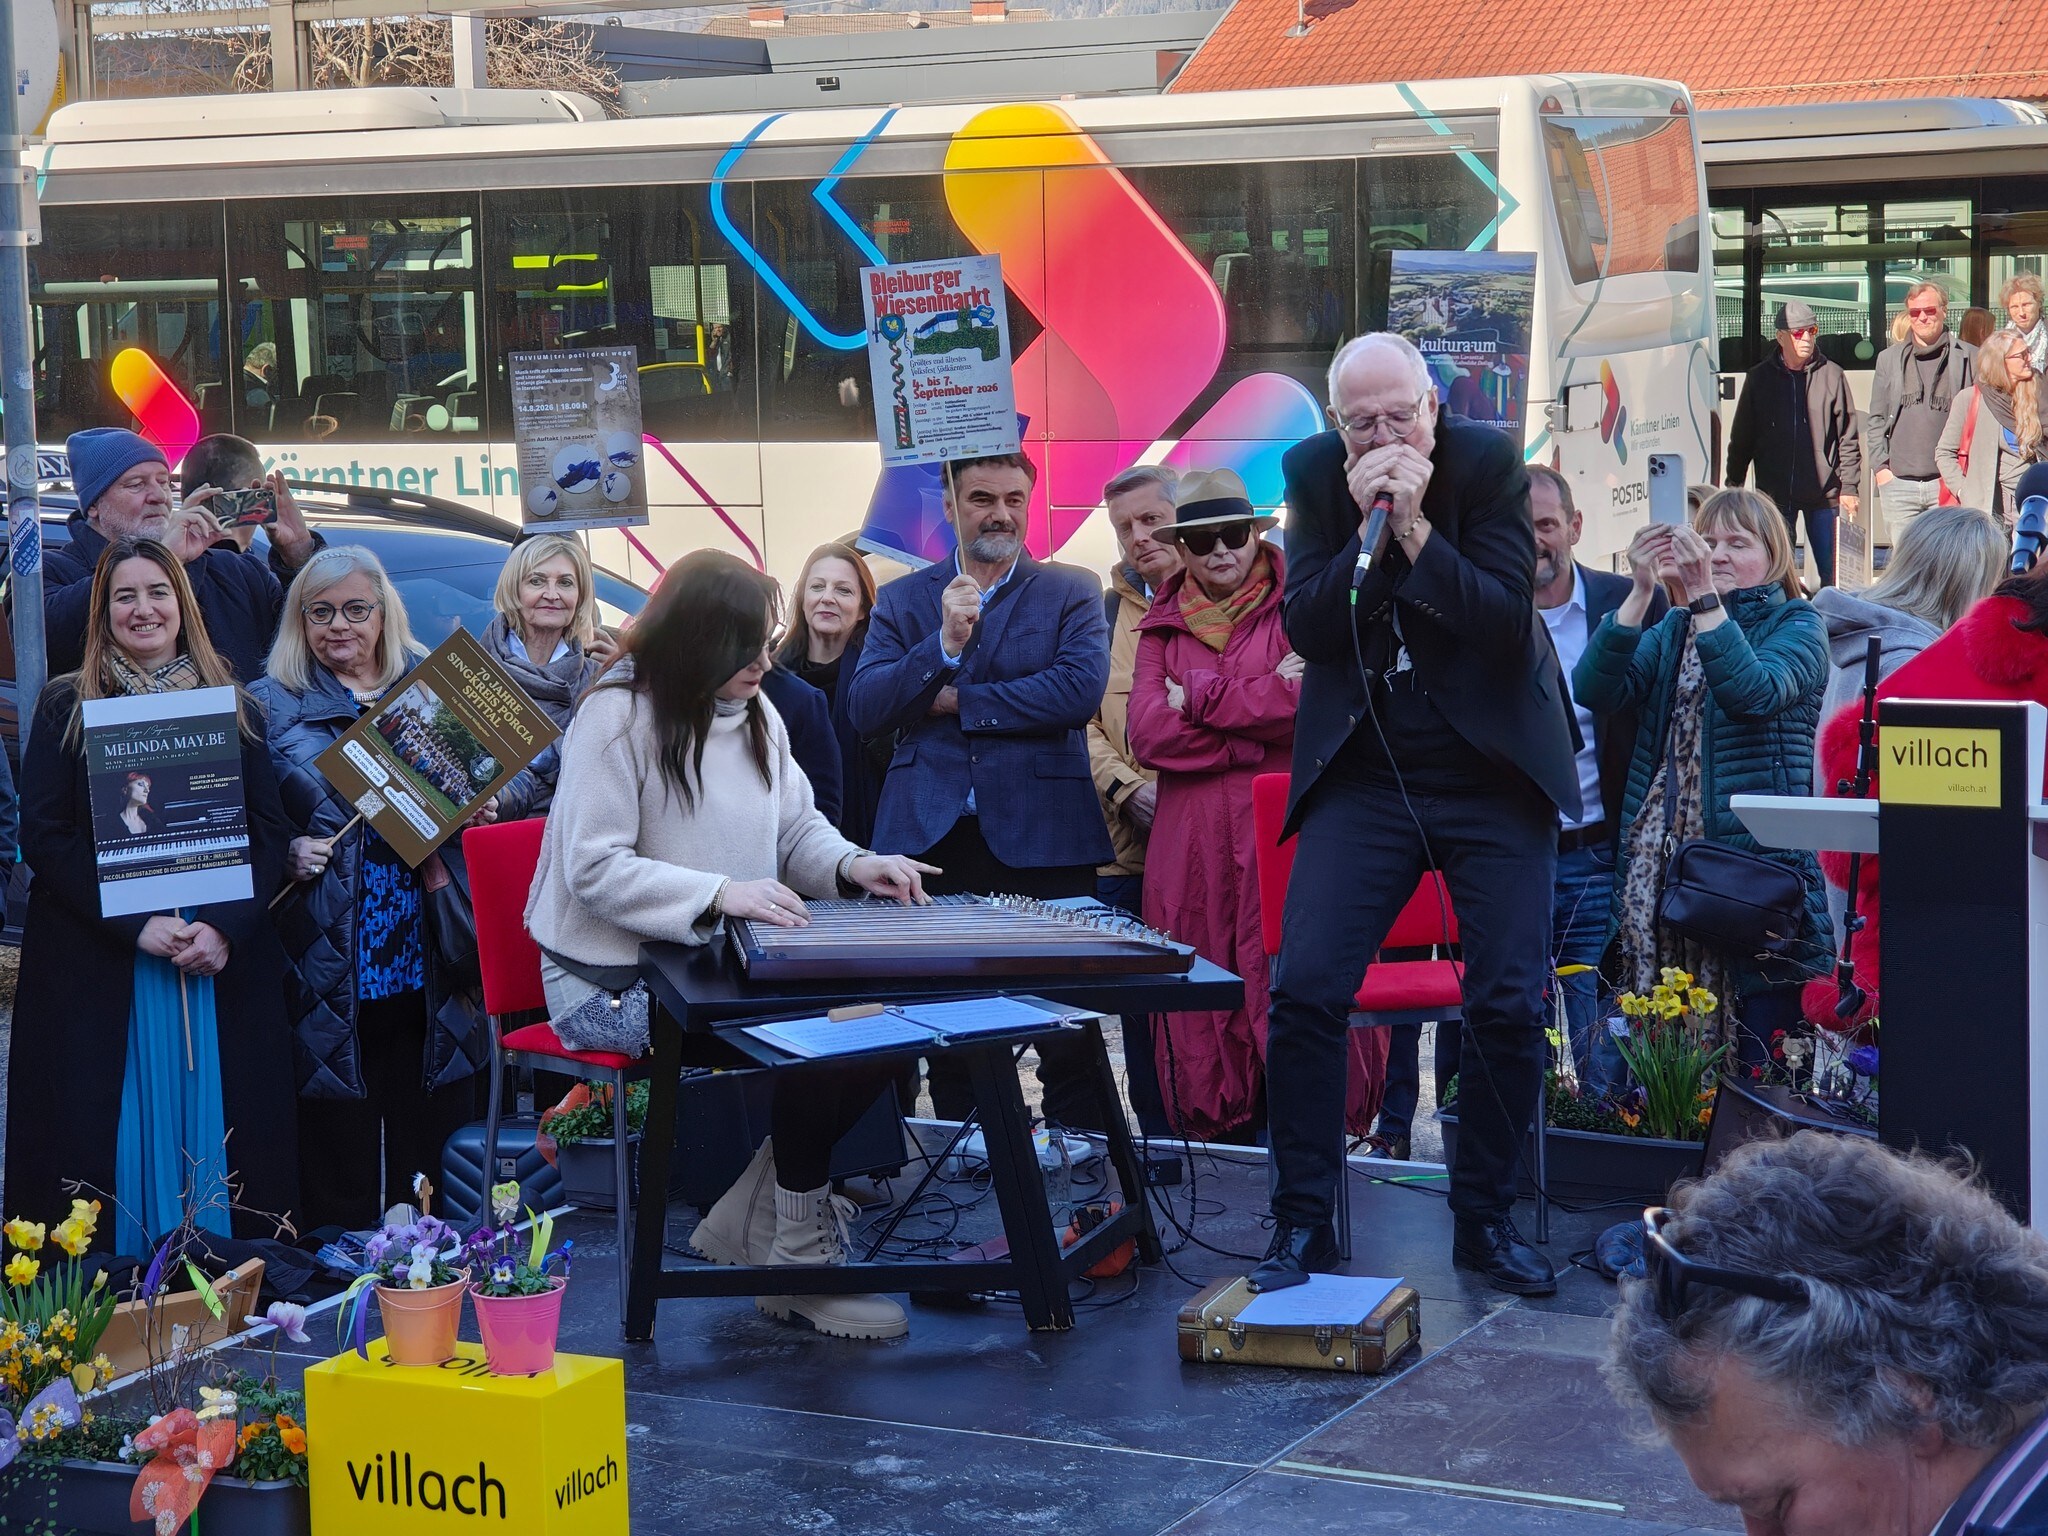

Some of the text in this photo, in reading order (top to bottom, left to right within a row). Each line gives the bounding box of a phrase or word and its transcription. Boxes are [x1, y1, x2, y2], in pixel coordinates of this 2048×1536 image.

[870, 270, 962, 295] Bleiburger
[872, 286, 991, 317] Wiesenmarkt
[910, 359, 932, 368] Größtes
[945, 356, 966, 364] ältestes
[912, 364, 971, 376] Volksfest Südkärntens
[913, 376, 952, 388] 4. bis 7.
[913, 383, 998, 400] September 2026
[519, 404, 554, 412] 14.8.2026
[561, 402, 581, 410] 18.00
[1631, 413, 1680, 436] Kärntner Linien
[264, 452, 438, 496] ärntner
[1612, 480, 1648, 507] POSTBU
[447, 652, 534, 745] SINGKREIS PORCIA
[477, 667, 523, 715] 70 JAHRE
[462, 685, 501, 728] SPITTAL
[104, 731, 226, 757] MELINDA MAY.BE
[1892, 738, 1987, 768] villach
[1947, 784, 1987, 793] villach.at
[103, 873, 125, 881] PICCOLA
[125, 868, 163, 878] DEGUSTAZIONE
[347, 1450, 506, 1520] villach
[555, 1454, 618, 1510] villach
